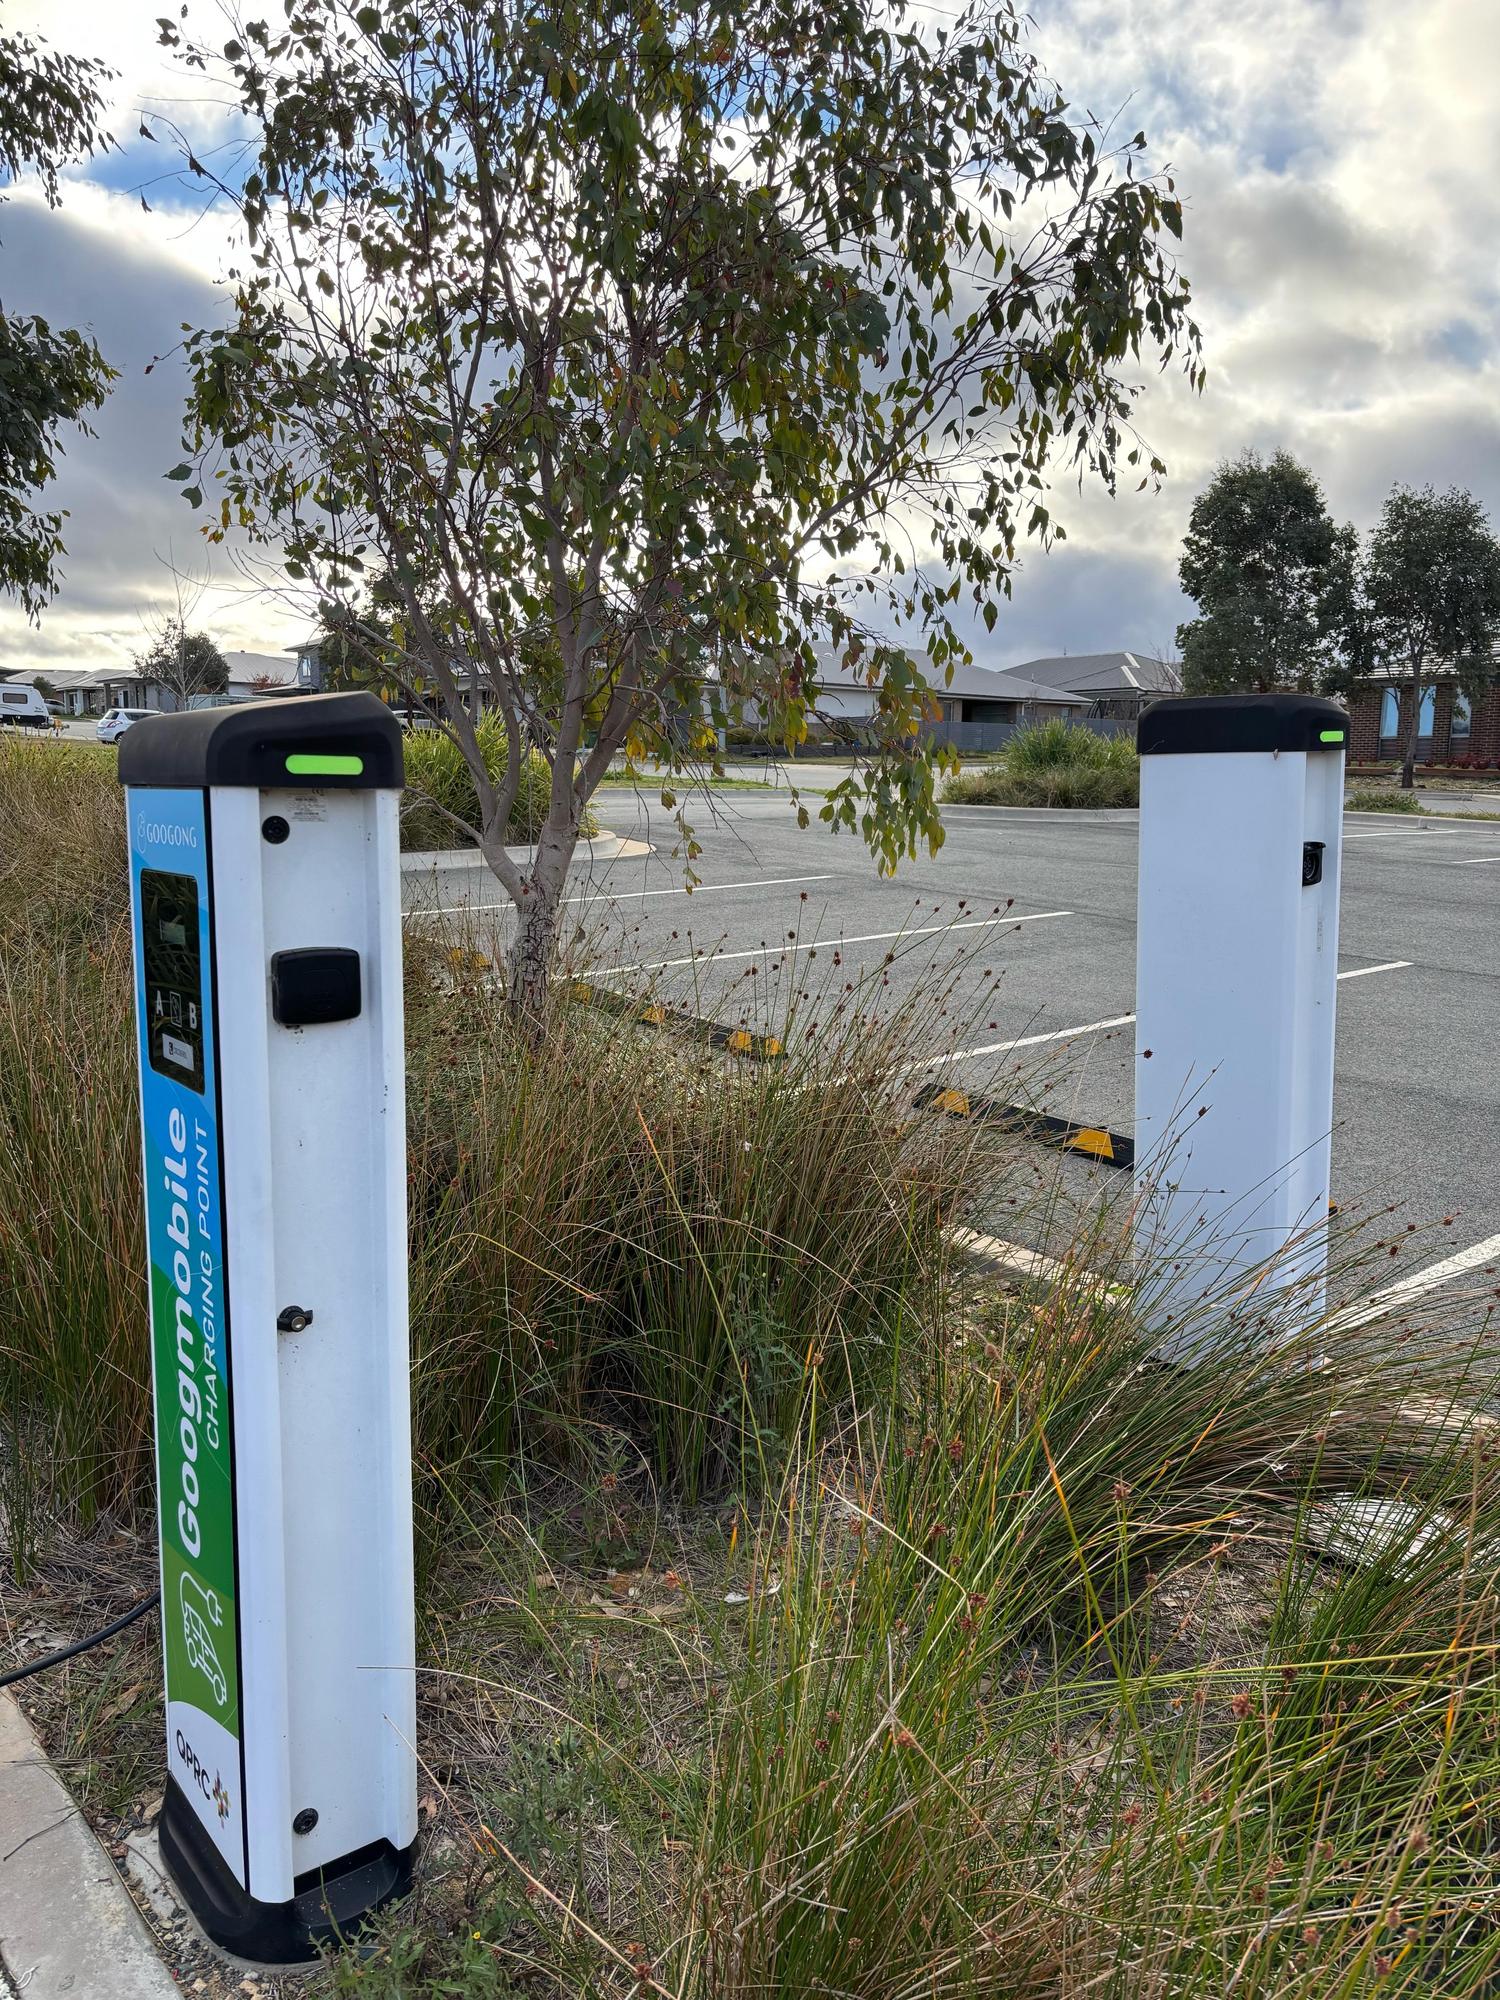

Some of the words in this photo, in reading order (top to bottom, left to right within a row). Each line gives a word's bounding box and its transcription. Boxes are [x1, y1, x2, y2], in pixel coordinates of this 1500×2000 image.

[146, 823, 198, 848] GOOGONG
[155, 990, 164, 1017] A
[188, 1002, 198, 1030] B
[195, 1117, 211, 1240] POINT
[164, 1107, 202, 1559] Googmobile
[200, 1249, 220, 1450] CHARGING
[176, 1728, 211, 1801] QPRC
